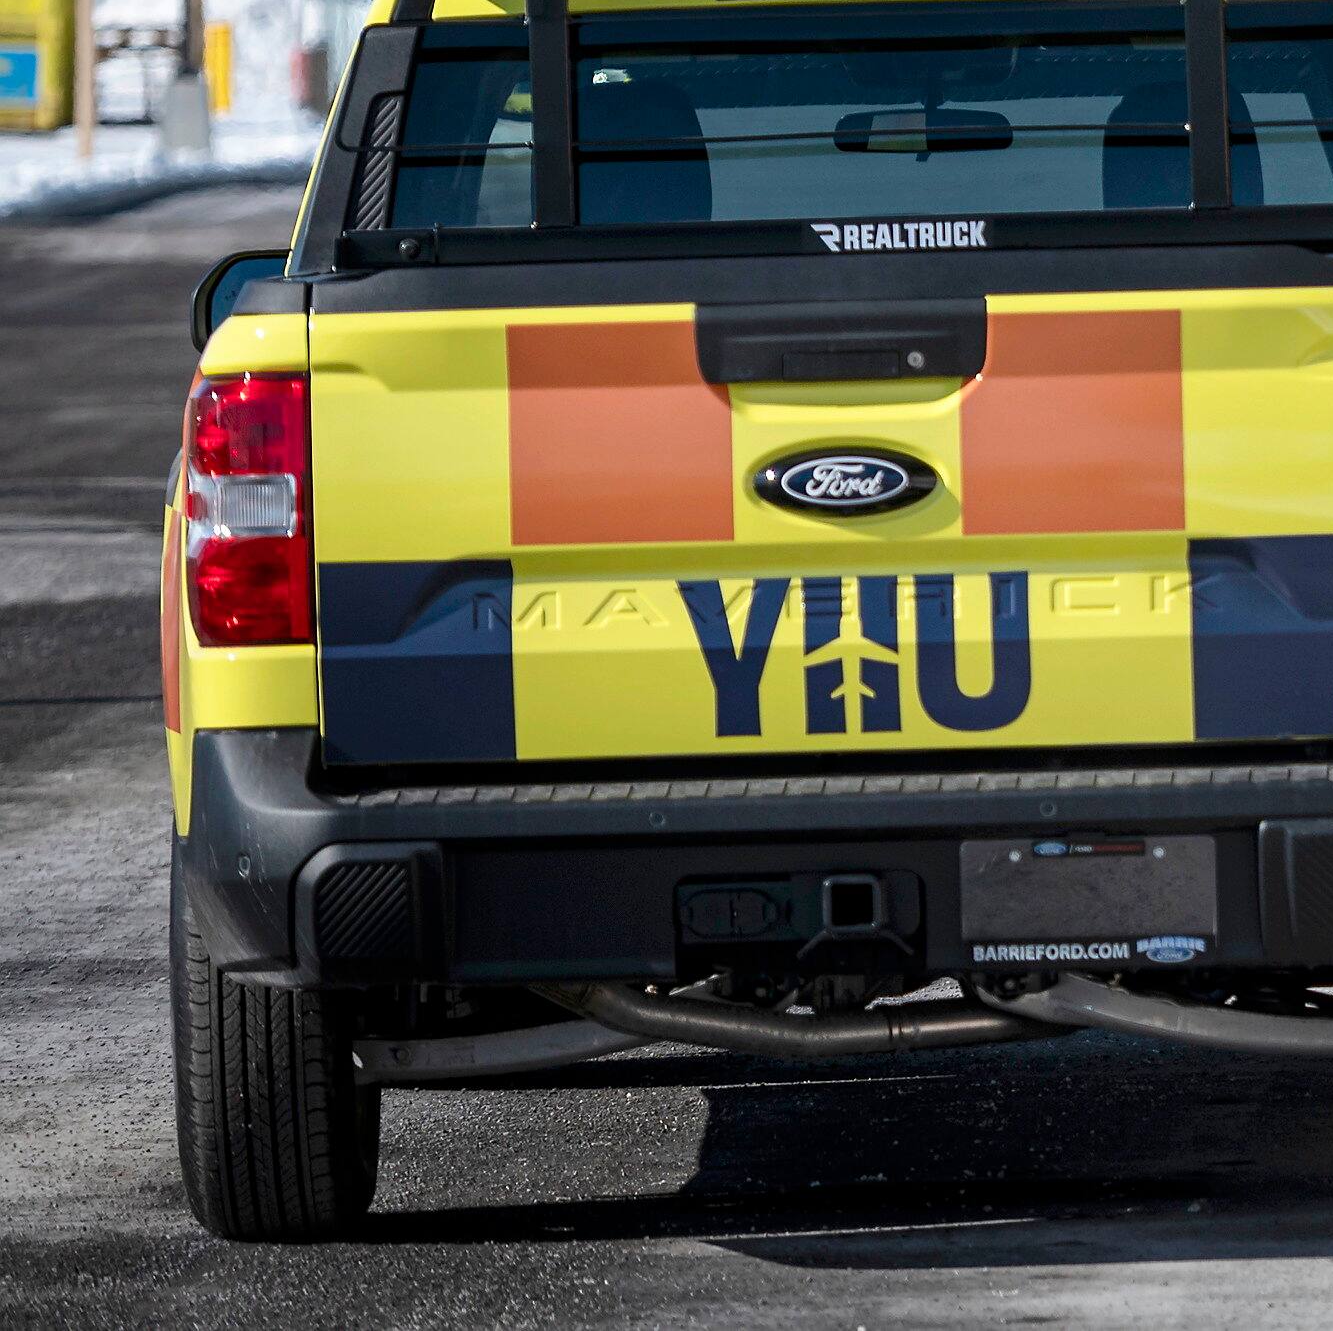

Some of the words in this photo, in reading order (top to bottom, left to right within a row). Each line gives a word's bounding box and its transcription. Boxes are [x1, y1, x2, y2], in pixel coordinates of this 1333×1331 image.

[843, 220, 988, 251] REALTRUCK
[806, 463, 884, 499] Ford
[470, 572, 1226, 632] MAVERICK
[973, 943, 1130, 962] BARRIEFORD.COM
